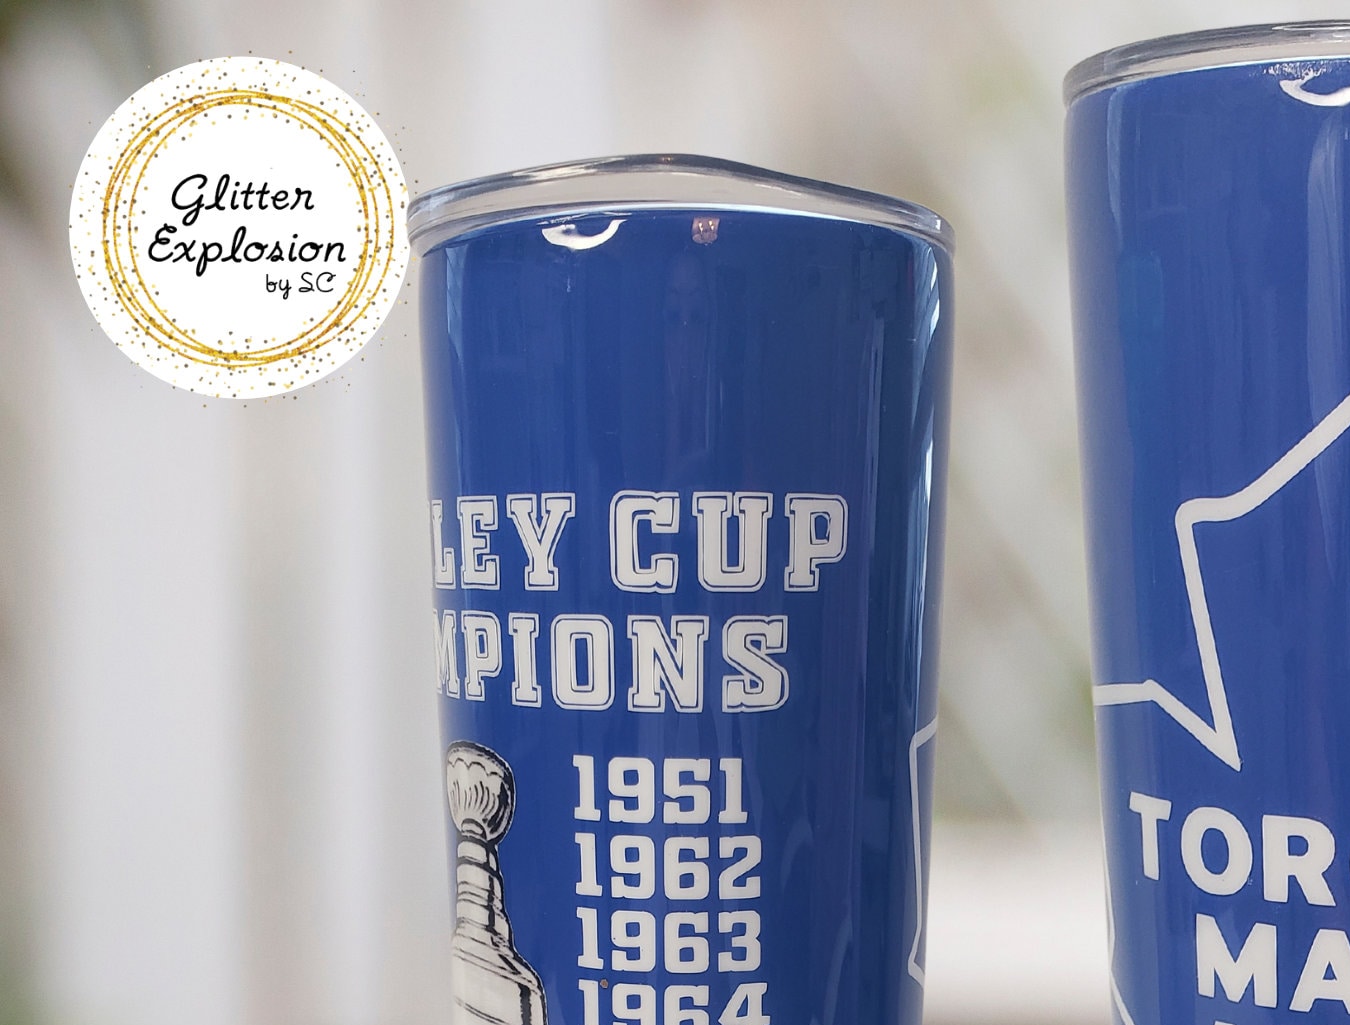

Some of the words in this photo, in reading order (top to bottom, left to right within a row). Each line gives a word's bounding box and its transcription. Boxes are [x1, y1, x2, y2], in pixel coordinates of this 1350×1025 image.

[431, 492, 576, 592] LEY
[609, 490, 849, 593] CUP
[432, 608, 790, 713] MPIONS
[571, 753, 749, 825] 1951
[573, 832, 763, 901] 1962
[575, 906, 762, 974] 1963
